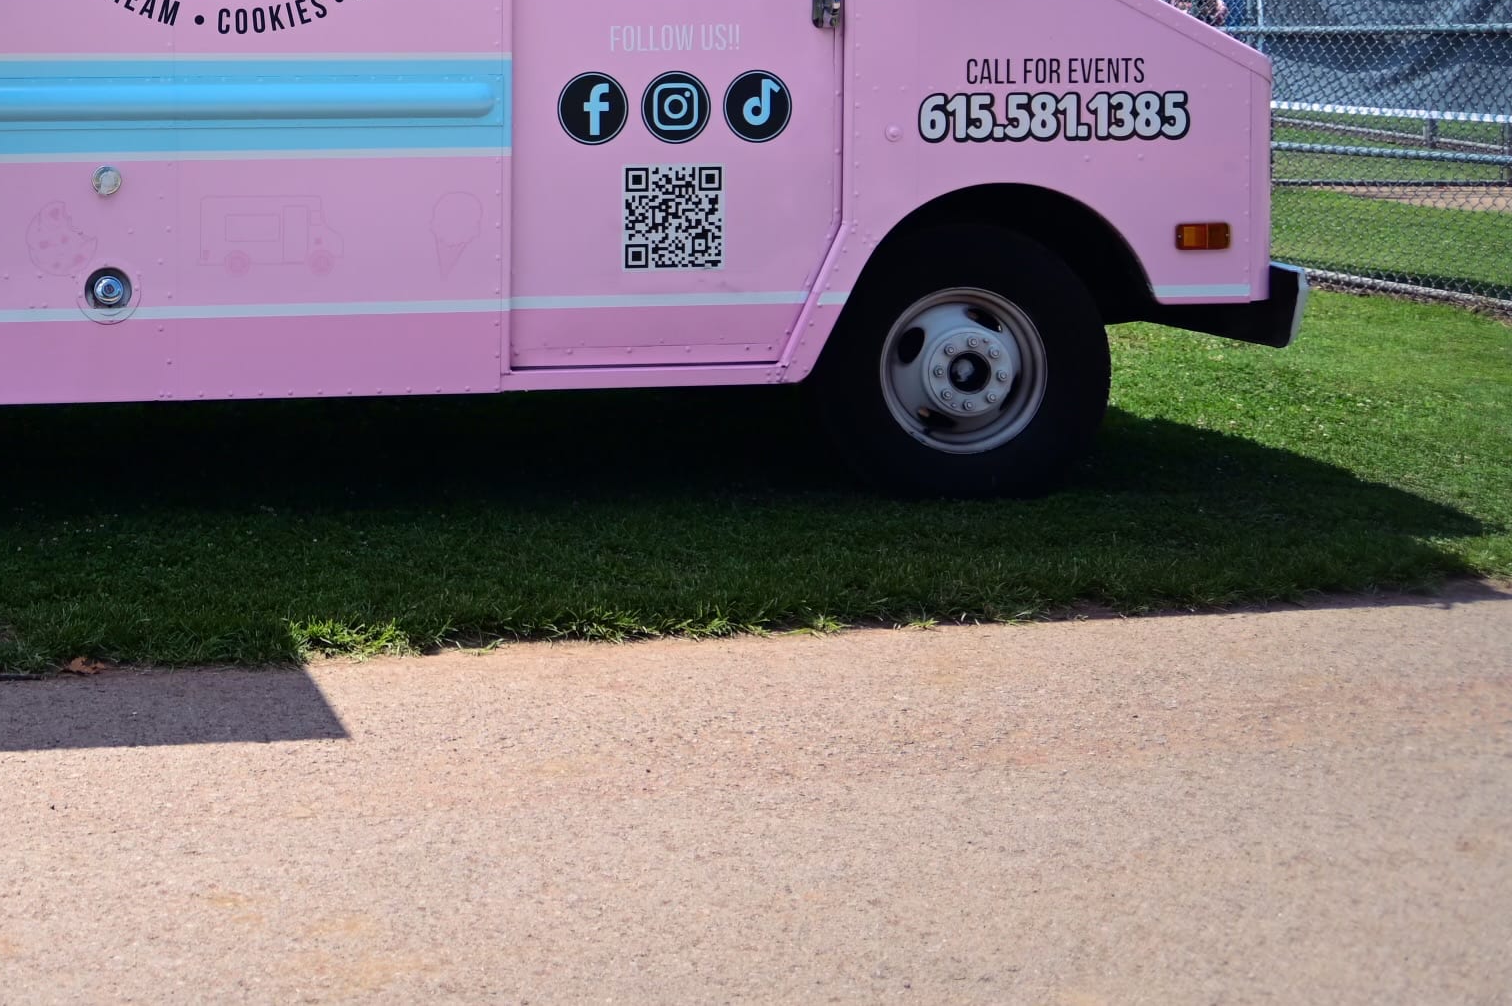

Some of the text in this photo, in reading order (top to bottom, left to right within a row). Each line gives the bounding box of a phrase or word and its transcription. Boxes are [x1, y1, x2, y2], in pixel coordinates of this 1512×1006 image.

[610, 24, 741, 52] FOLLOW US!!
[966, 57, 1145, 84] CALL FOR EVENTS
[918, 90, 1191, 144] 615.581.1385
